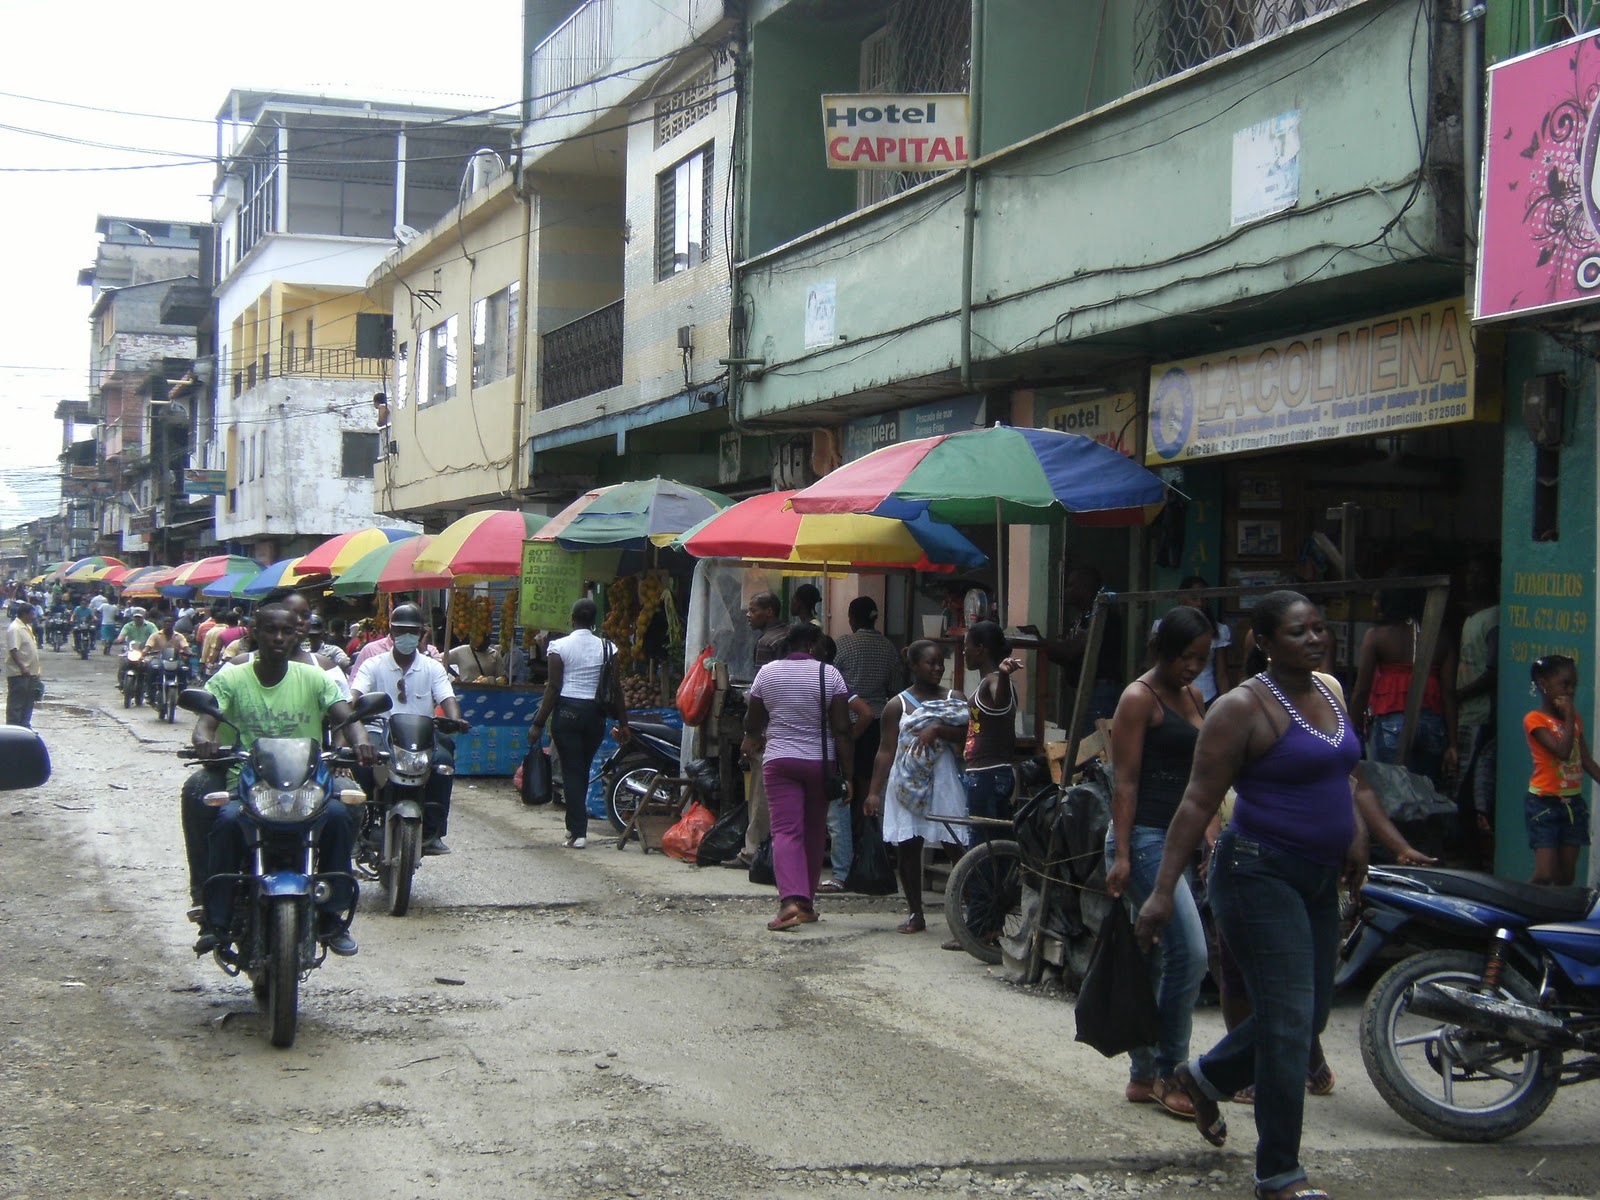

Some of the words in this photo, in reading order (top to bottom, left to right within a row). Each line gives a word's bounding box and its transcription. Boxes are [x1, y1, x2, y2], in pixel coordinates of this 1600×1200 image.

[826, 103, 936, 127] Hotel
[829, 136, 968, 163] CAPITAL
[1199, 355, 1245, 423] LA
[1253, 307, 1467, 413] COLMENA
[916, 412, 935, 424] Pescado
[1054, 404, 1100, 432] Hotel
[1346, 417, 1378, 433] Servicio
[1386, 411, 1422, 427] Domicilio
[848, 421, 897, 449] Pesquera
[1513, 572, 1584, 597] DOMICILIOS
